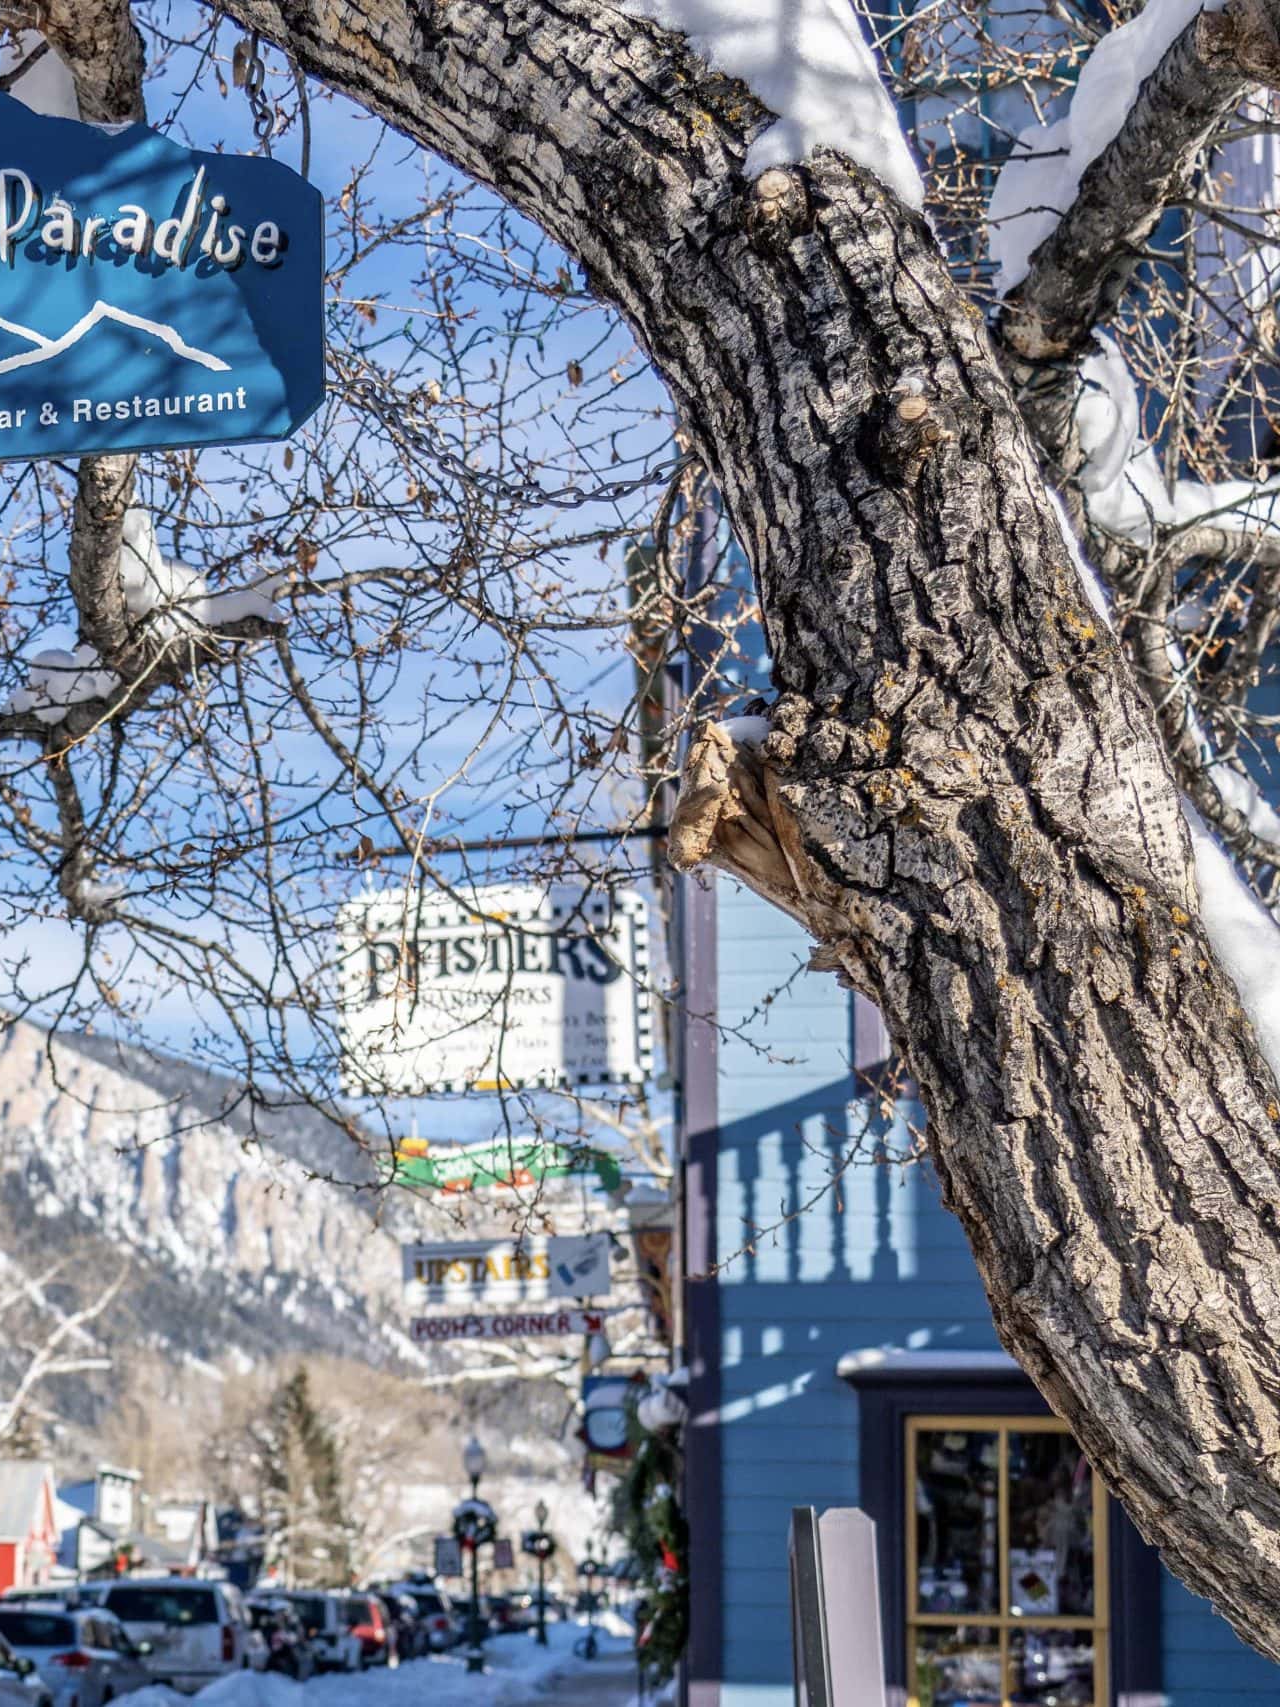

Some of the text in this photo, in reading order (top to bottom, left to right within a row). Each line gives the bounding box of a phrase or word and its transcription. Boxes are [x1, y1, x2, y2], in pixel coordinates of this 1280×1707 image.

[39, 401, 59, 426] &
[73, 386, 247, 423] Restaurant
[414, 1253, 551, 1284] UPSTAIRS
[492, 1313, 571, 1336] CORNER
